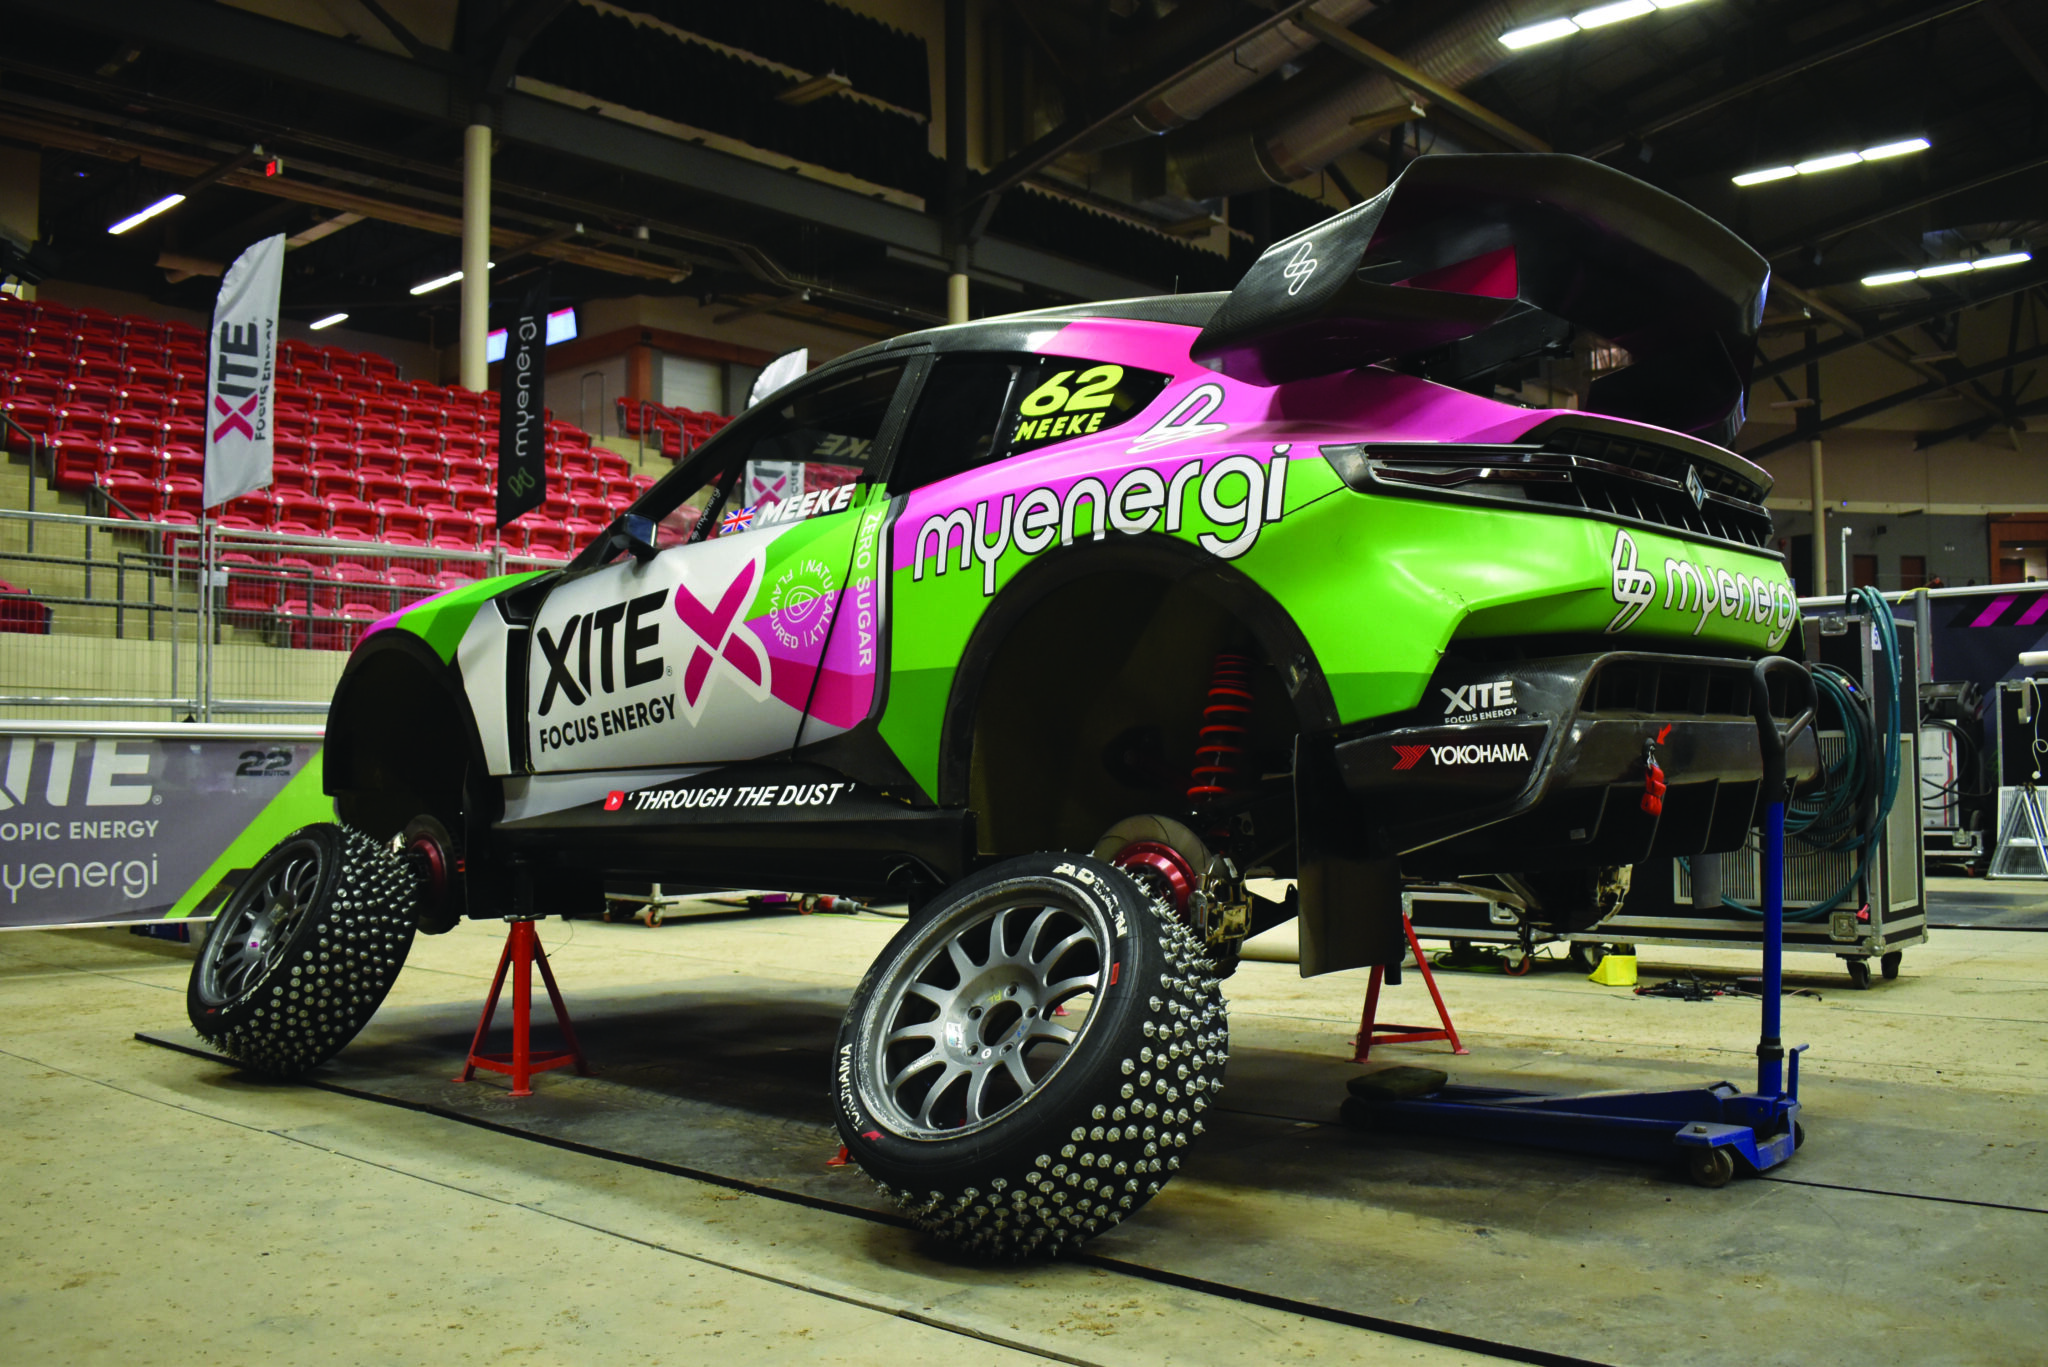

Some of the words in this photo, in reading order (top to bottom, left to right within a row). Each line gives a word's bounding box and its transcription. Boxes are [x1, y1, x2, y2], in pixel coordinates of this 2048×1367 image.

[213, 321, 258, 443] XITE
[1020, 364, 1124, 417] 62
[1015, 412, 1106, 442] MEEKE
[757, 483, 857, 526] MEEKE
[913, 443, 1292, 597] myenergi
[856, 511, 883, 569] ZERO
[769, 569, 799, 649] FLAVOURED
[805, 559, 835, 645] NATURALLY
[856, 575, 872, 667] SUGAR
[1663, 557, 1797, 649] myenergi
[537, 588, 670, 717] XITE
[539, 714, 599, 753] FOCUS
[602, 693, 676, 738] ENERGY
[1440, 680, 1515, 715] XITE
[1444, 713, 1479, 725] FOCUS
[1480, 706, 1518, 721] ENERGY
[0, 738, 155, 811] ITE
[236, 750, 293, 776] 22
[1430, 743, 1529, 766] YOKOHAMA
[634, 788, 732, 811] THROUGH
[733, 785, 780, 807] THE
[777, 782, 845, 806] DUST
[0, 822, 61, 841] OPIC
[69, 820, 160, 839] ENERGY
[3, 852, 158, 904] yenergi
